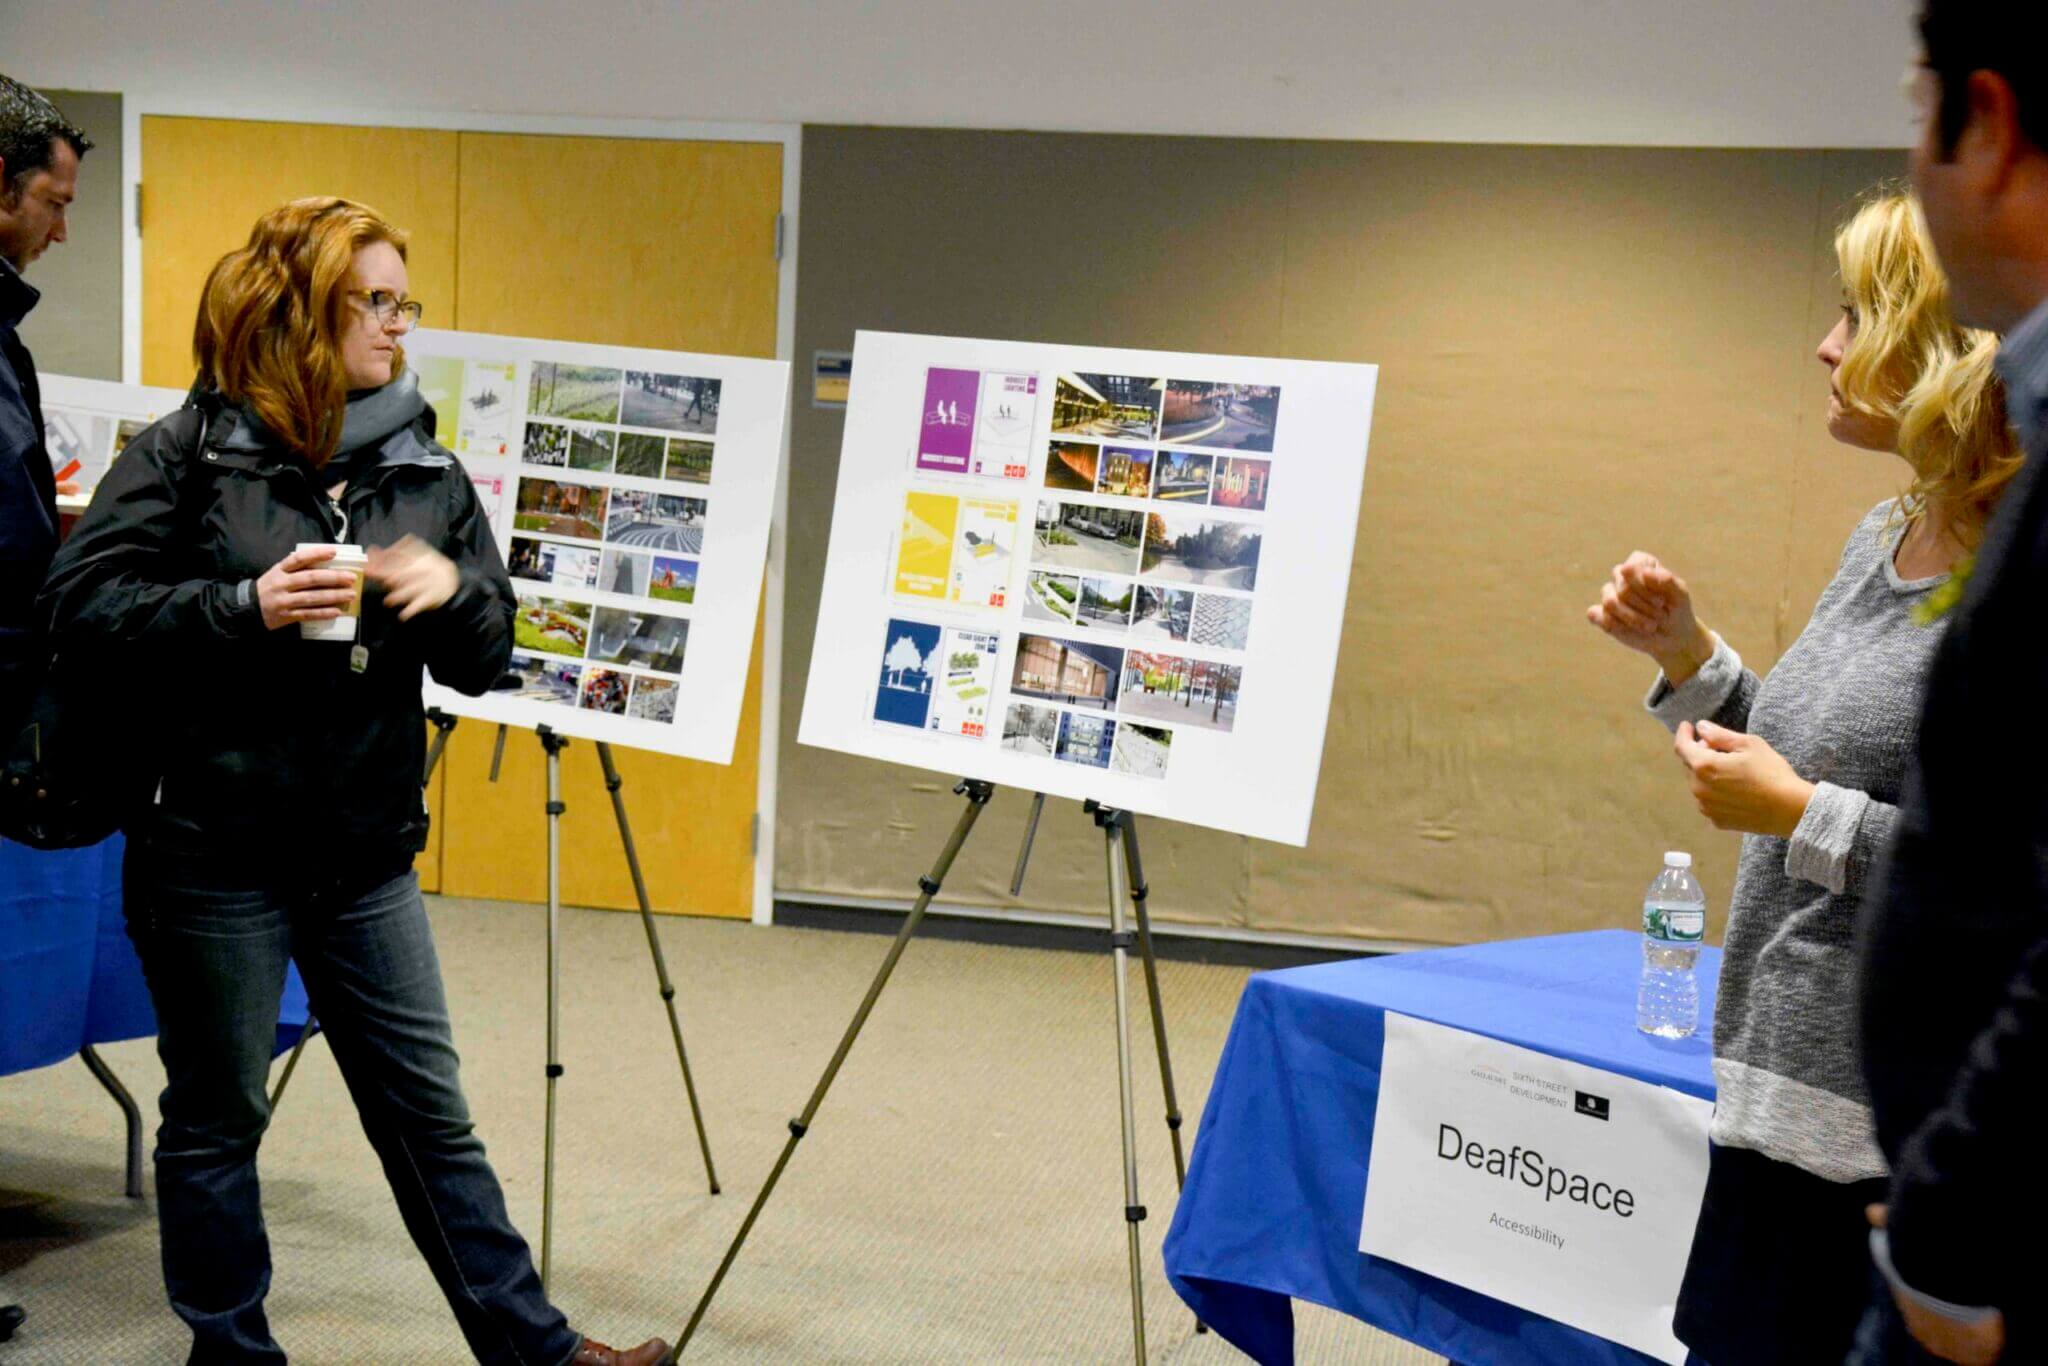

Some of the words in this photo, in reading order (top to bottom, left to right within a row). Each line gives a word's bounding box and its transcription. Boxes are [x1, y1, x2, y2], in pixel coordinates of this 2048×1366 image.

[1510, 1085, 1568, 1108] DEVELOPMENT
[1512, 1072, 1535, 1085] SIXTH
[1536, 1078, 1568, 1094] STREET
[1437, 1123, 1635, 1218] DeafSpace
[1489, 1212, 1566, 1250] Accessibility
